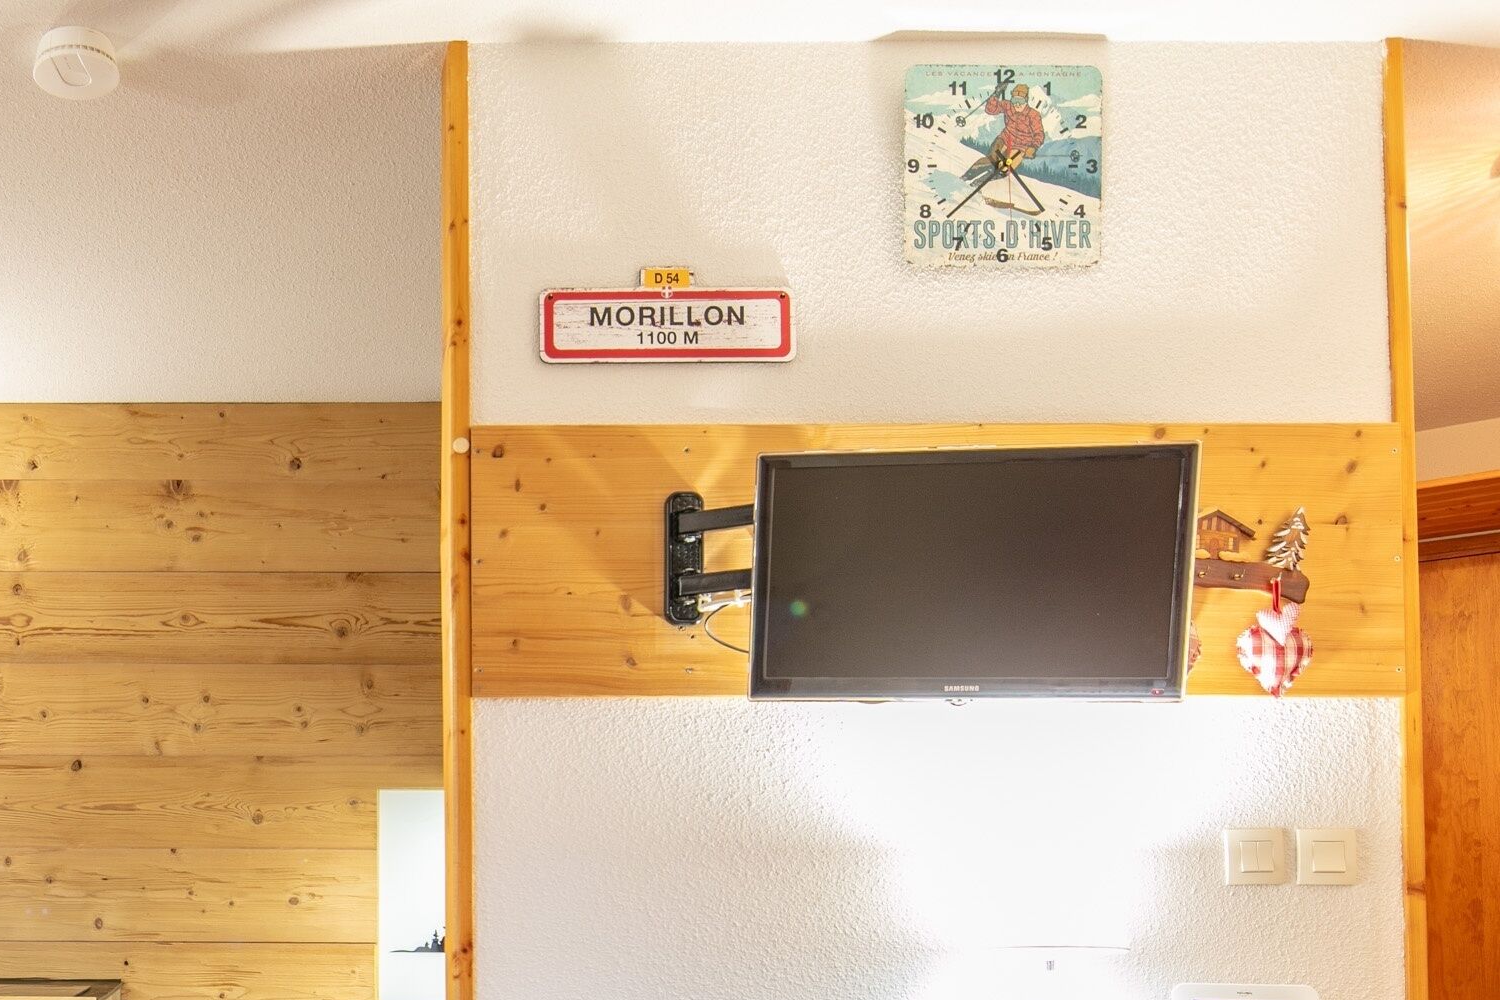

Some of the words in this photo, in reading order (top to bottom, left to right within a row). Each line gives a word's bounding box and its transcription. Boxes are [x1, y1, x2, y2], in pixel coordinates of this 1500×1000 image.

[993, 69, 1015, 84] 12
[948, 81, 967, 96] 11
[1043, 81, 1052, 96] 1
[913, 114, 934, 129] 10
[1075, 114, 1087, 129] 2
[907, 159, 920, 174] 9
[1086, 159, 1098, 174] 3
[919, 204, 932, 219] 8
[1073, 204, 1086, 219] 4
[913, 219, 996, 250] SPORTS
[1005, 219, 1092, 250] D'HIVER
[952, 236, 965, 251] 7
[1041, 236, 1053, 251] 5
[948, 251, 975, 262] Venez
[977, 251, 999, 261] skie
[1017, 251, 1050, 261] France
[996, 248, 1008, 263] 6
[654, 272, 664, 284] D
[666, 272, 680, 284] 54
[589, 305, 745, 327] MORILLON
[637, 331, 677, 345] 1100
[683, 331, 699, 345] M
[943, 684, 980, 692] SAMSUNG
